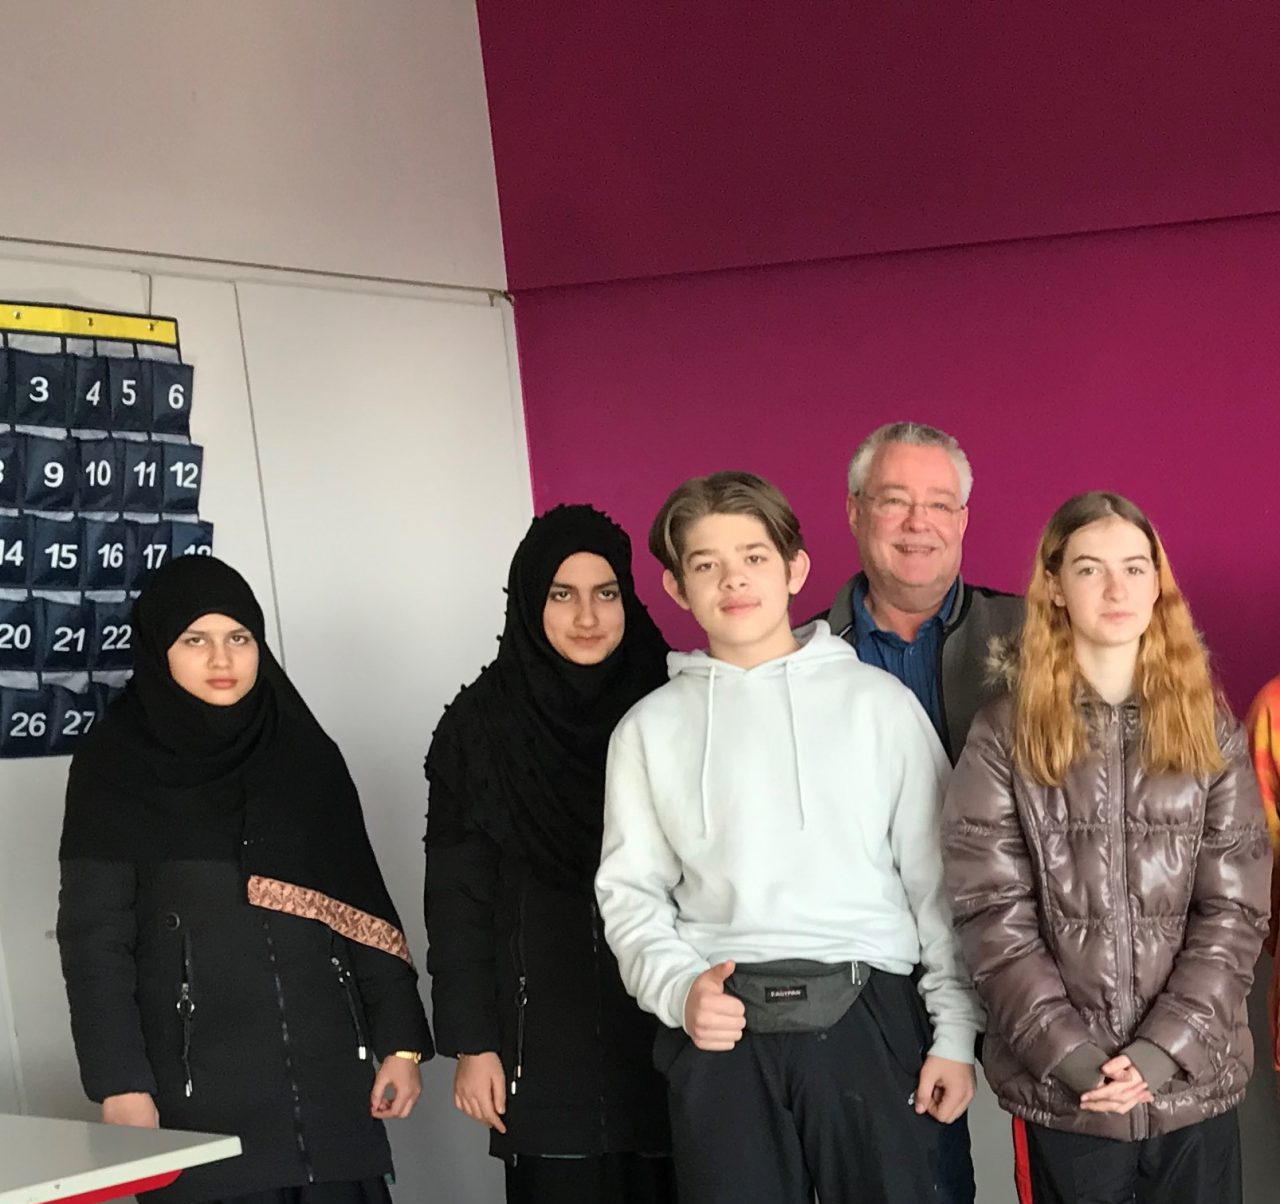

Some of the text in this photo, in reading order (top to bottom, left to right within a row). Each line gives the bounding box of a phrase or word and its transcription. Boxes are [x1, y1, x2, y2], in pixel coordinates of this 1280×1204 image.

[29, 376, 185, 409] 3 4 5 6
[43, 459, 199, 489] 9 10 11 12
[44, 543, 79, 569] 15
[97, 543, 124, 569] 16
[143, 544, 168, 570] 17
[0, 623, 132, 652] 20 21 22
[10, 709, 96, 737] 26 27
